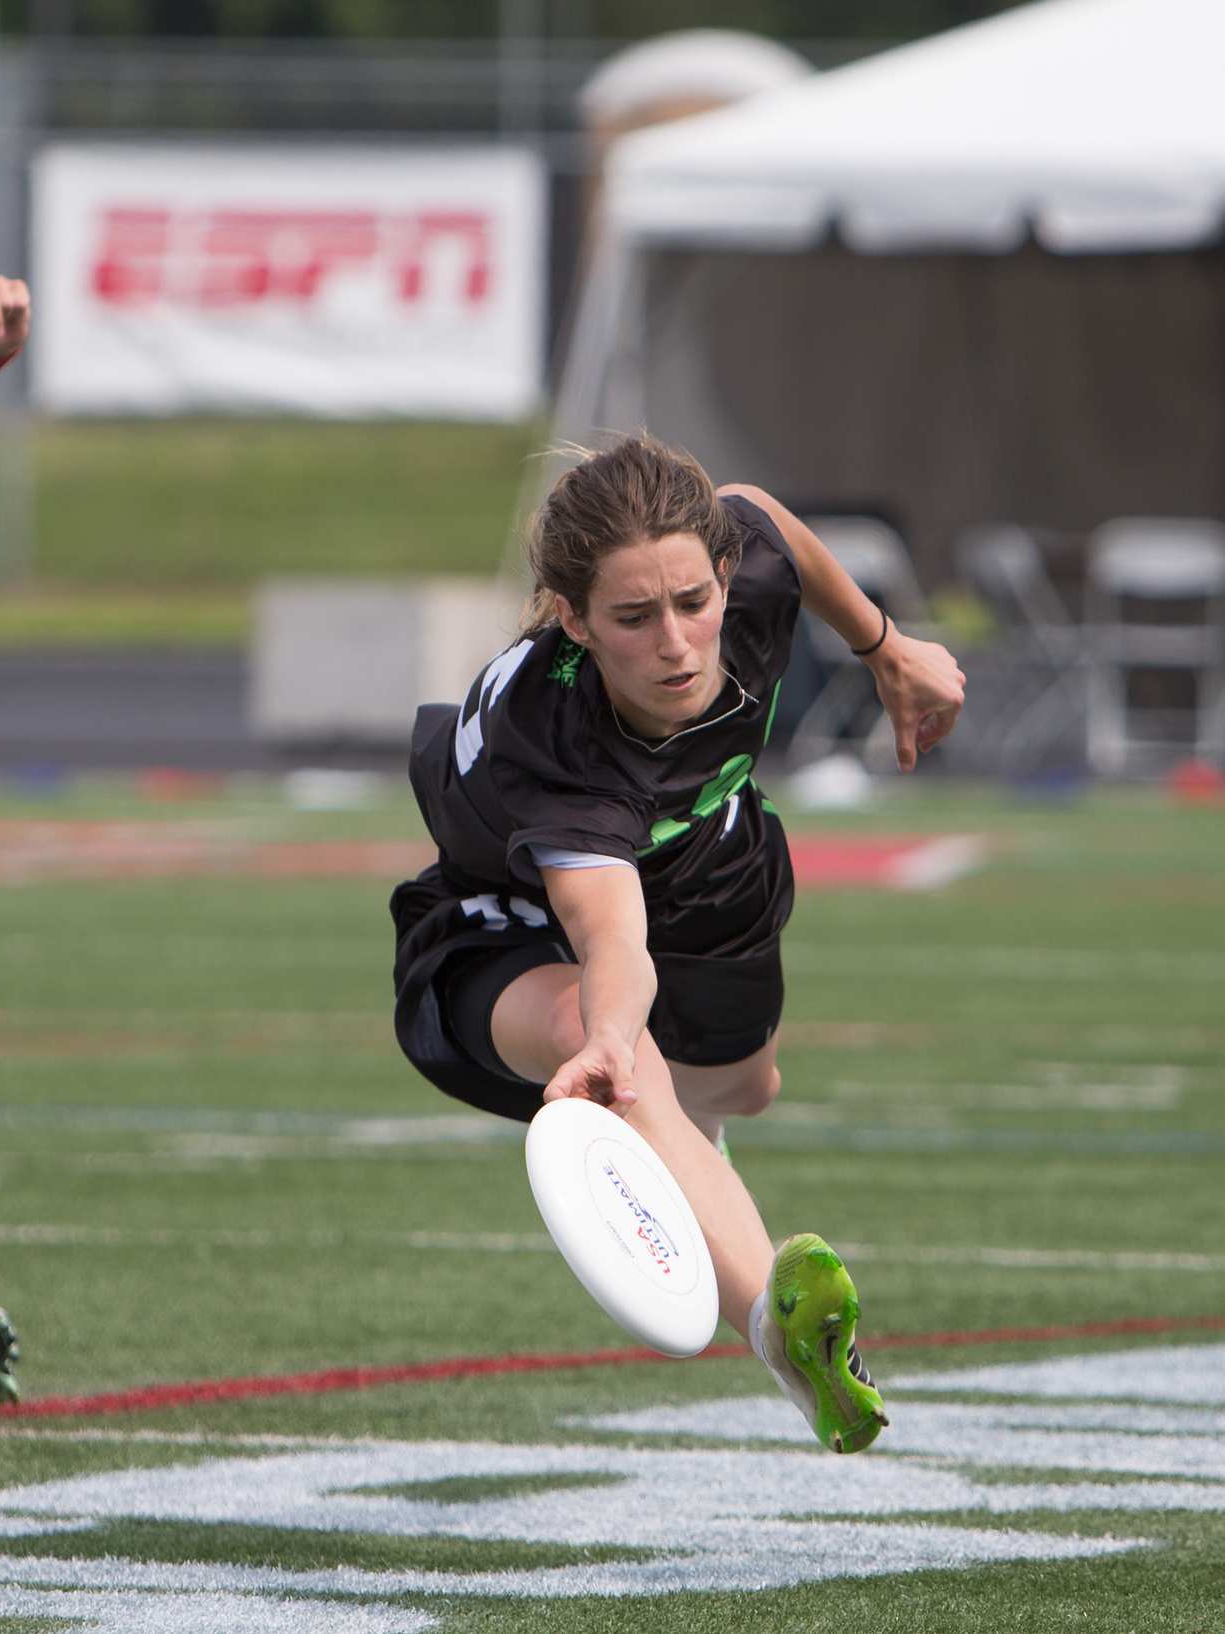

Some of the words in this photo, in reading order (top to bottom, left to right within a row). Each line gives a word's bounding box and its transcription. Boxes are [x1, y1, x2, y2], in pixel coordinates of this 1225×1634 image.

[90, 204, 493, 308] ESPN
[603, 1165, 670, 1258] ULTIMATE
[636, 1226, 671, 1274] USA
